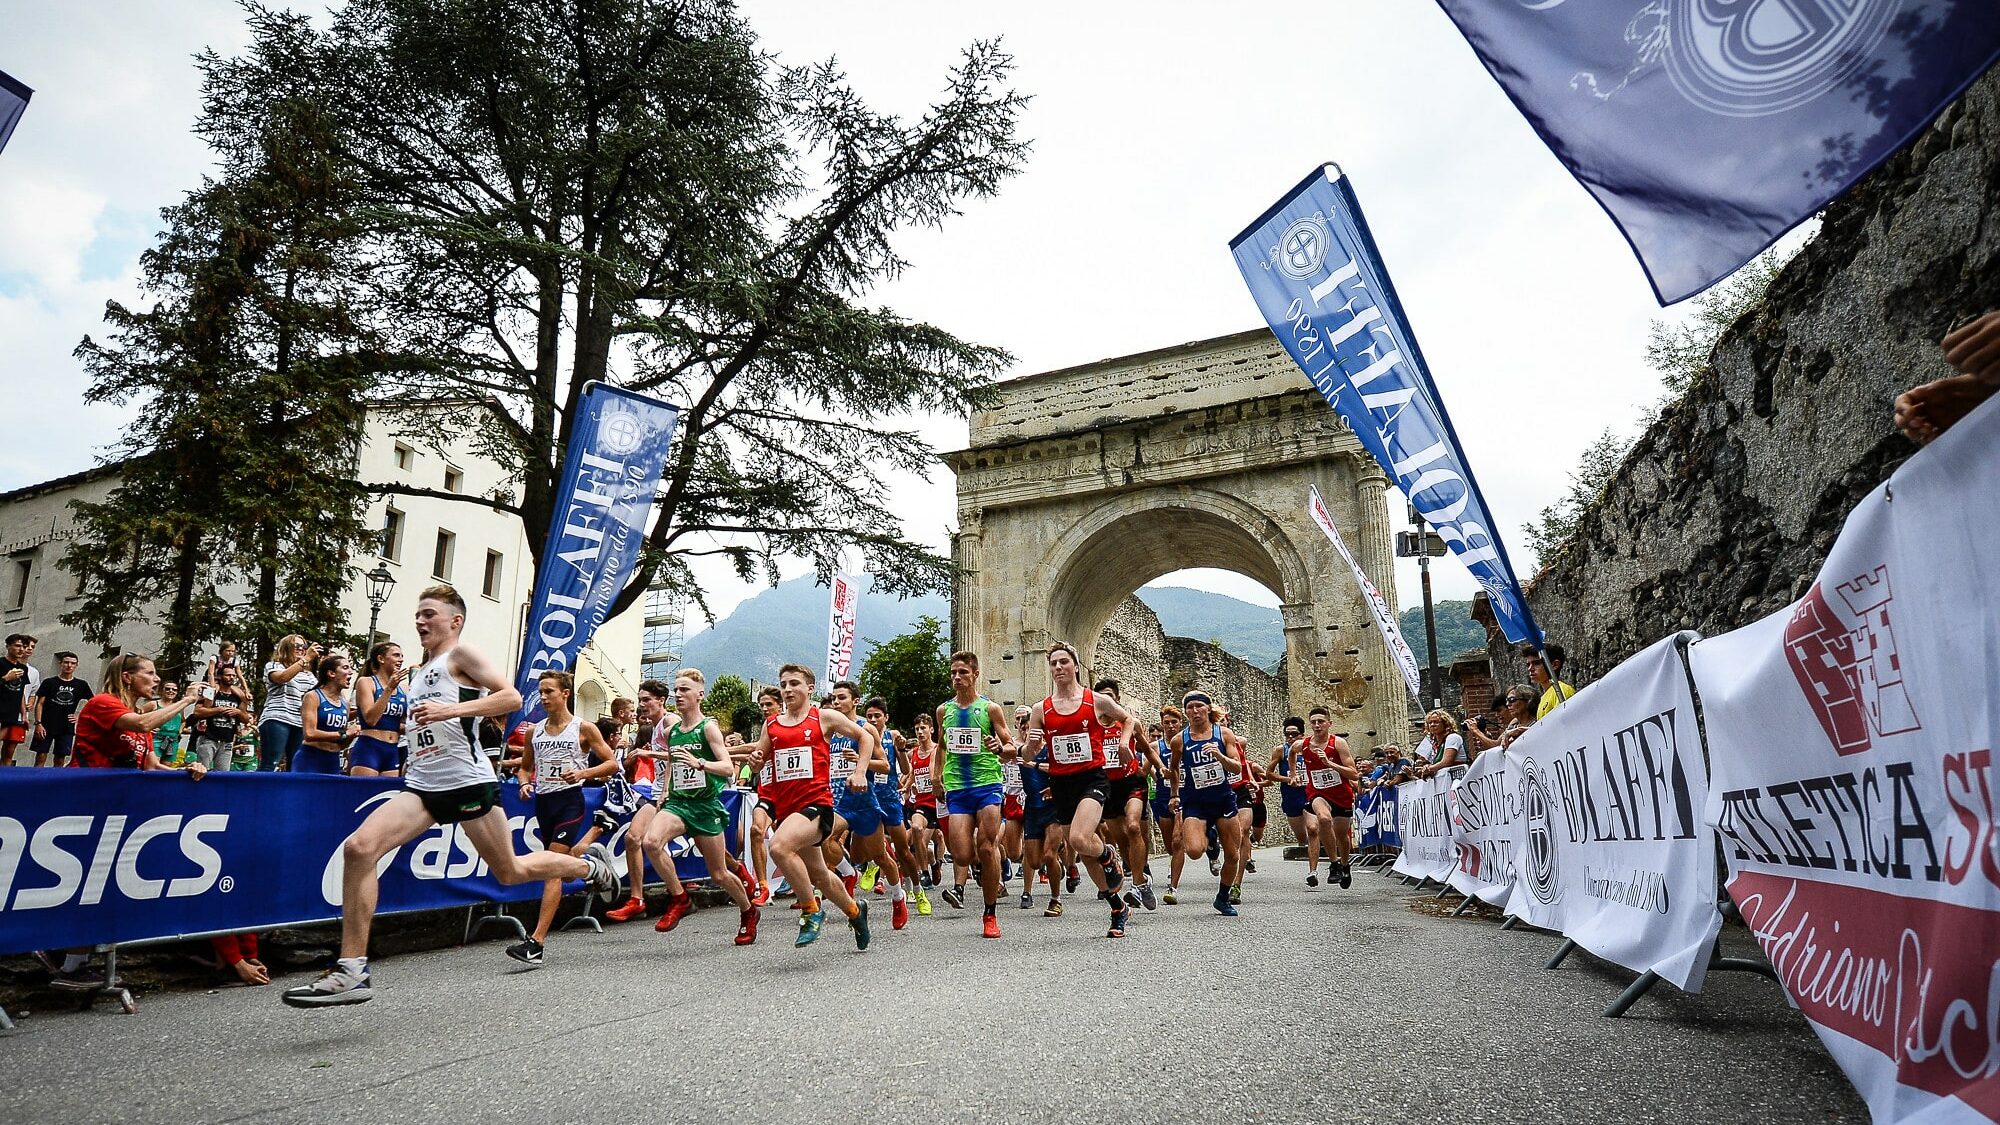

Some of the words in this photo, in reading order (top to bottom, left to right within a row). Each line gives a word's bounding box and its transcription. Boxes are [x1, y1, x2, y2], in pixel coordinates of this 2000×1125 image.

[620, 465, 646, 513] 1890
[613, 516, 631, 553] dal
[527, 448, 625, 684] BOLAFFI
[326, 713, 347, 728] USA
[417, 729, 435, 748] 46
[959, 734, 973, 744] 66
[539, 741, 574, 750] FRANCE
[1066, 741, 1081, 753] 88
[1108, 750, 1119, 760] 72
[787, 756, 800, 769] 87
[837, 759, 849, 769] 38
[550, 766, 562, 777] 21
[683, 769, 696, 780] 32
[1205, 769, 1217, 779] 79
[1322, 773, 1333, 782] 86
[1552, 706, 1697, 844] BOLAFFI
[1718, 761, 1943, 883] ATLETICA
[1739, 880, 1892, 1027] Adriano
